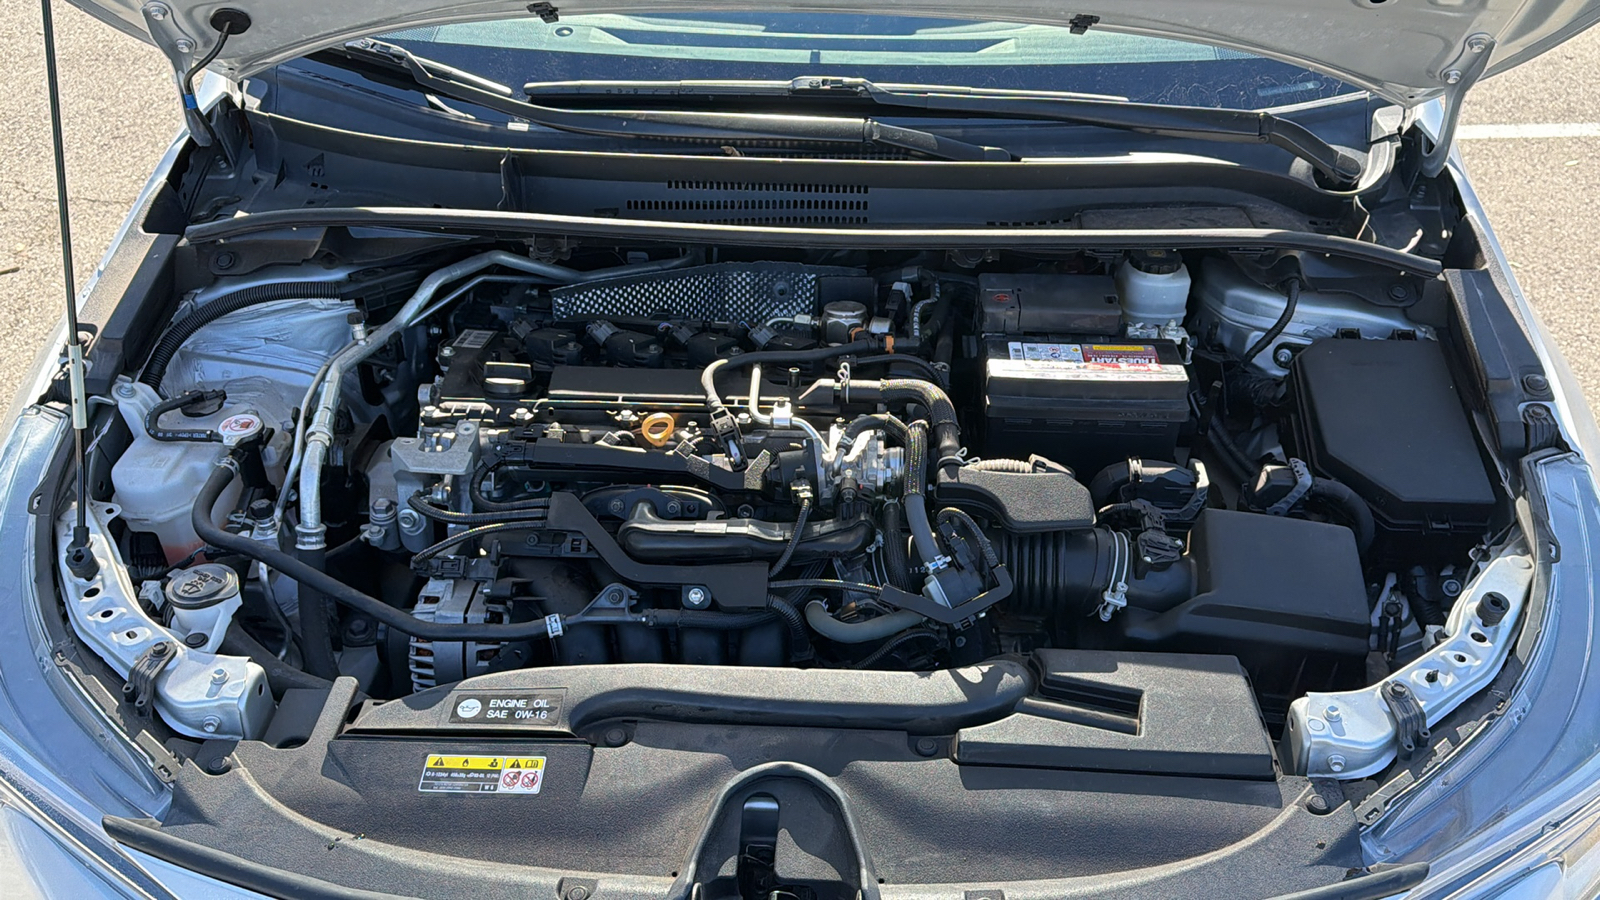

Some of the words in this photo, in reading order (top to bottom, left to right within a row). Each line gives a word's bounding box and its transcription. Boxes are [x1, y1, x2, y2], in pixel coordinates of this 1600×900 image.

[489, 699, 527, 708] ENGINE
[533, 699, 549, 708] OIL
[486, 709, 508, 719] SAE
[514, 710, 548, 719] 0W-16
